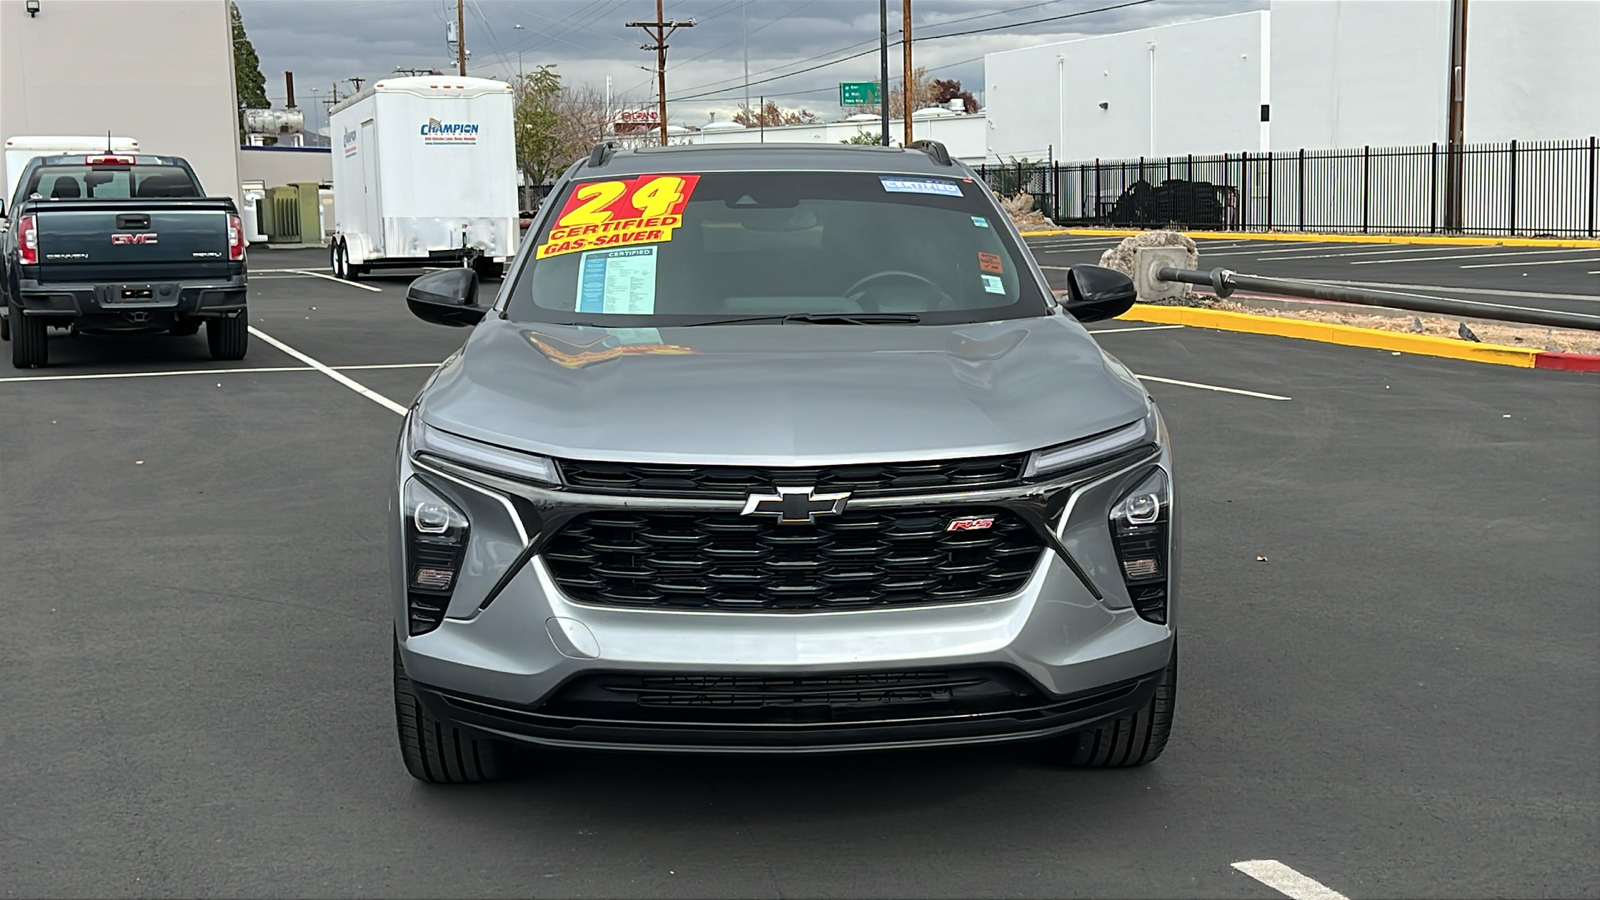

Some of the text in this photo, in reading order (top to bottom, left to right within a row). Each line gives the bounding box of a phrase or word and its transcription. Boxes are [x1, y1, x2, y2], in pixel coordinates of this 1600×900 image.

[420, 123, 479, 136] CHAMPION
[558, 176, 686, 228] 24
[550, 216, 679, 240] CERTIFIED
[111, 233, 158, 245] GMC
[544, 229, 663, 255] GAS-SAVER
[608, 249, 650, 258] CERTIFIED
[946, 518, 994, 531] RS
